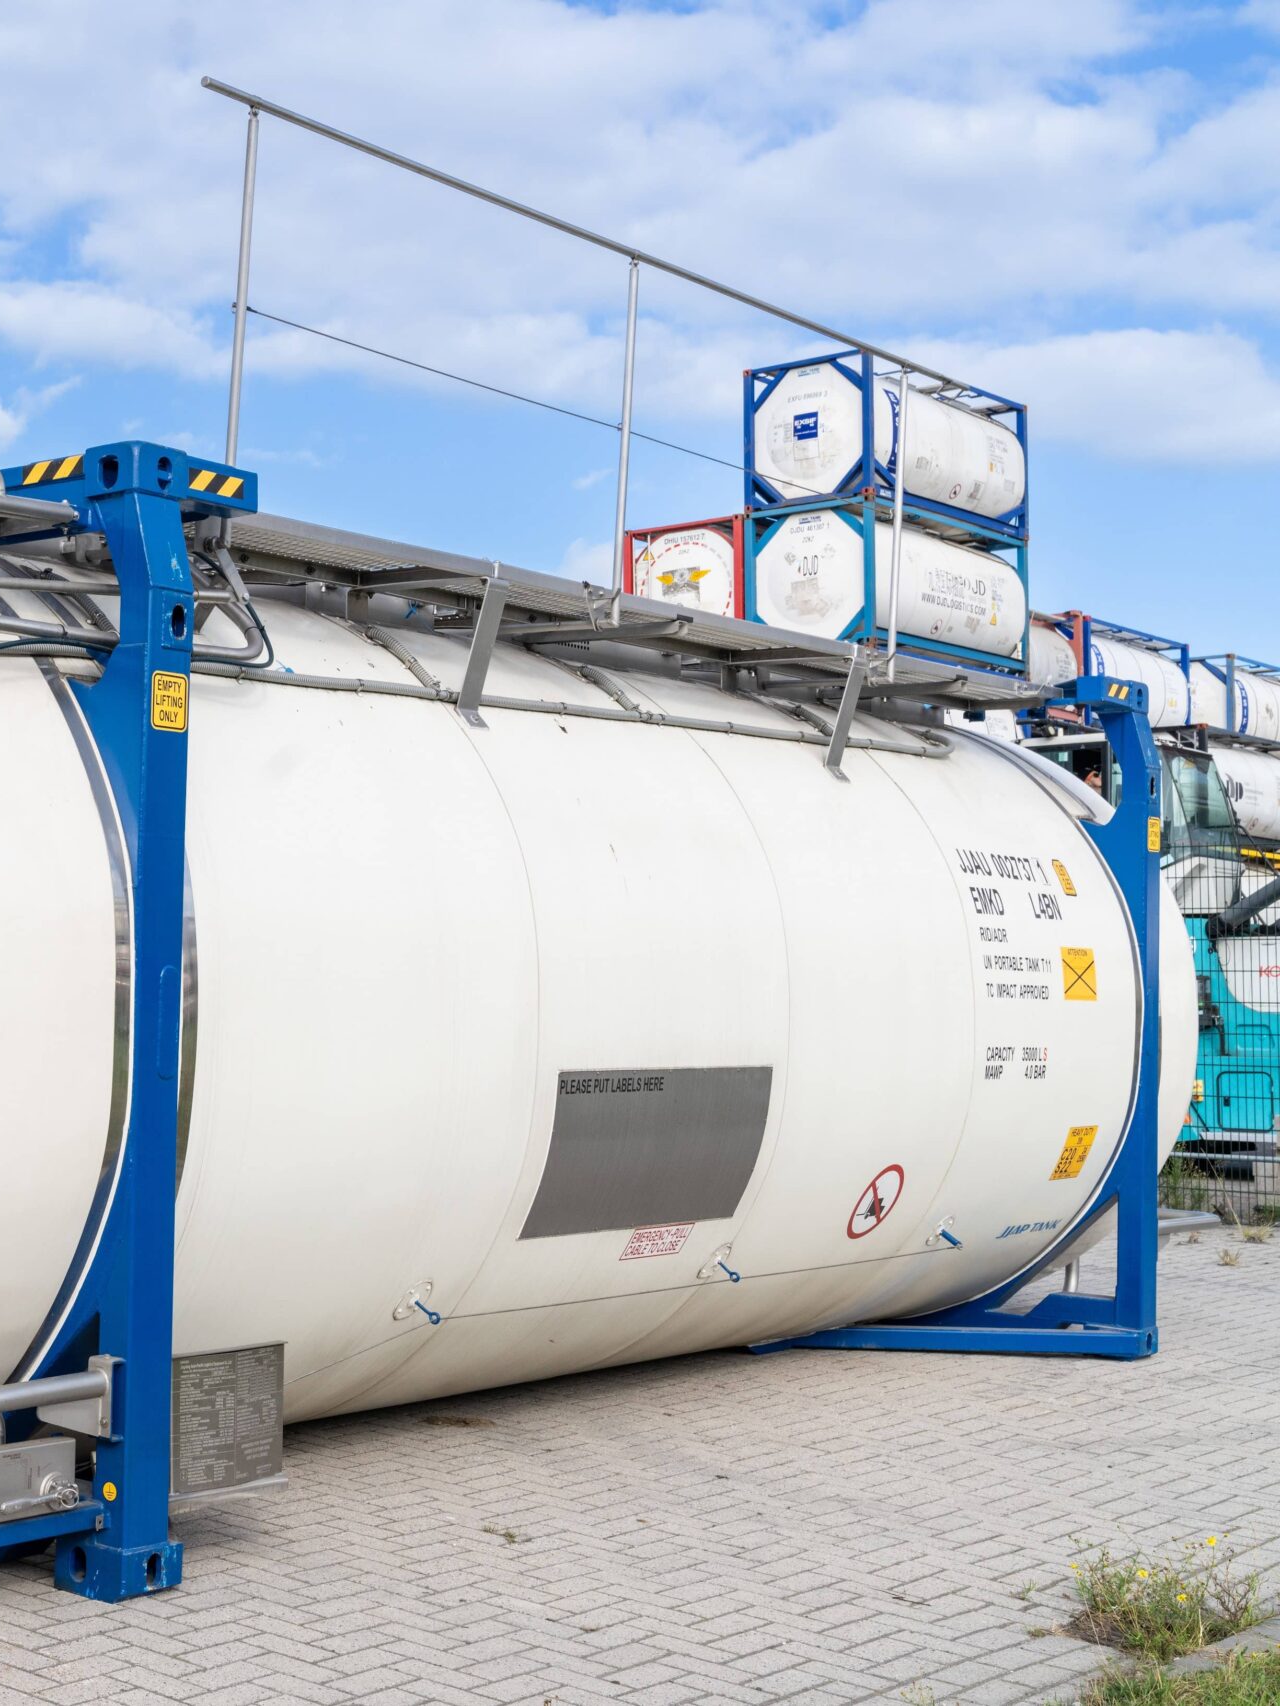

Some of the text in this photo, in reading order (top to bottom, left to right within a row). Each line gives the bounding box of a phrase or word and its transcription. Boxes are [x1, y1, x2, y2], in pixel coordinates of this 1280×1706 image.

[803, 555, 819, 576] DJD
[158, 679, 181, 693] EMPTY
[156, 694, 182, 709] LIFTING
[159, 709, 178, 723] ONLY
[956, 848, 992, 876] JJAU
[990, 853, 1036, 882] 002737
[1036, 859, 1049, 884] 1
[969, 886, 1062, 920] EMKD L4BN
[980, 927, 1008, 942] RID/ADR
[983, 955, 1052, 973] UN PORTABLE TANK T11
[986, 982, 1049, 1000] TC IMPACT APPROVED
[986, 1046, 1015, 1062] CAPACITY
[1022, 1047, 1037, 1062] 35000
[985, 1064, 1046, 1080] MAWP 4.0 BAR
[560, 1076, 664, 1095] PLEASE PUT LABELS HERE
[995, 1219, 1062, 1239] JJAP TANK
[624, 1244, 649, 1257] CABLE
[658, 1239, 681, 1253] CLOSE
